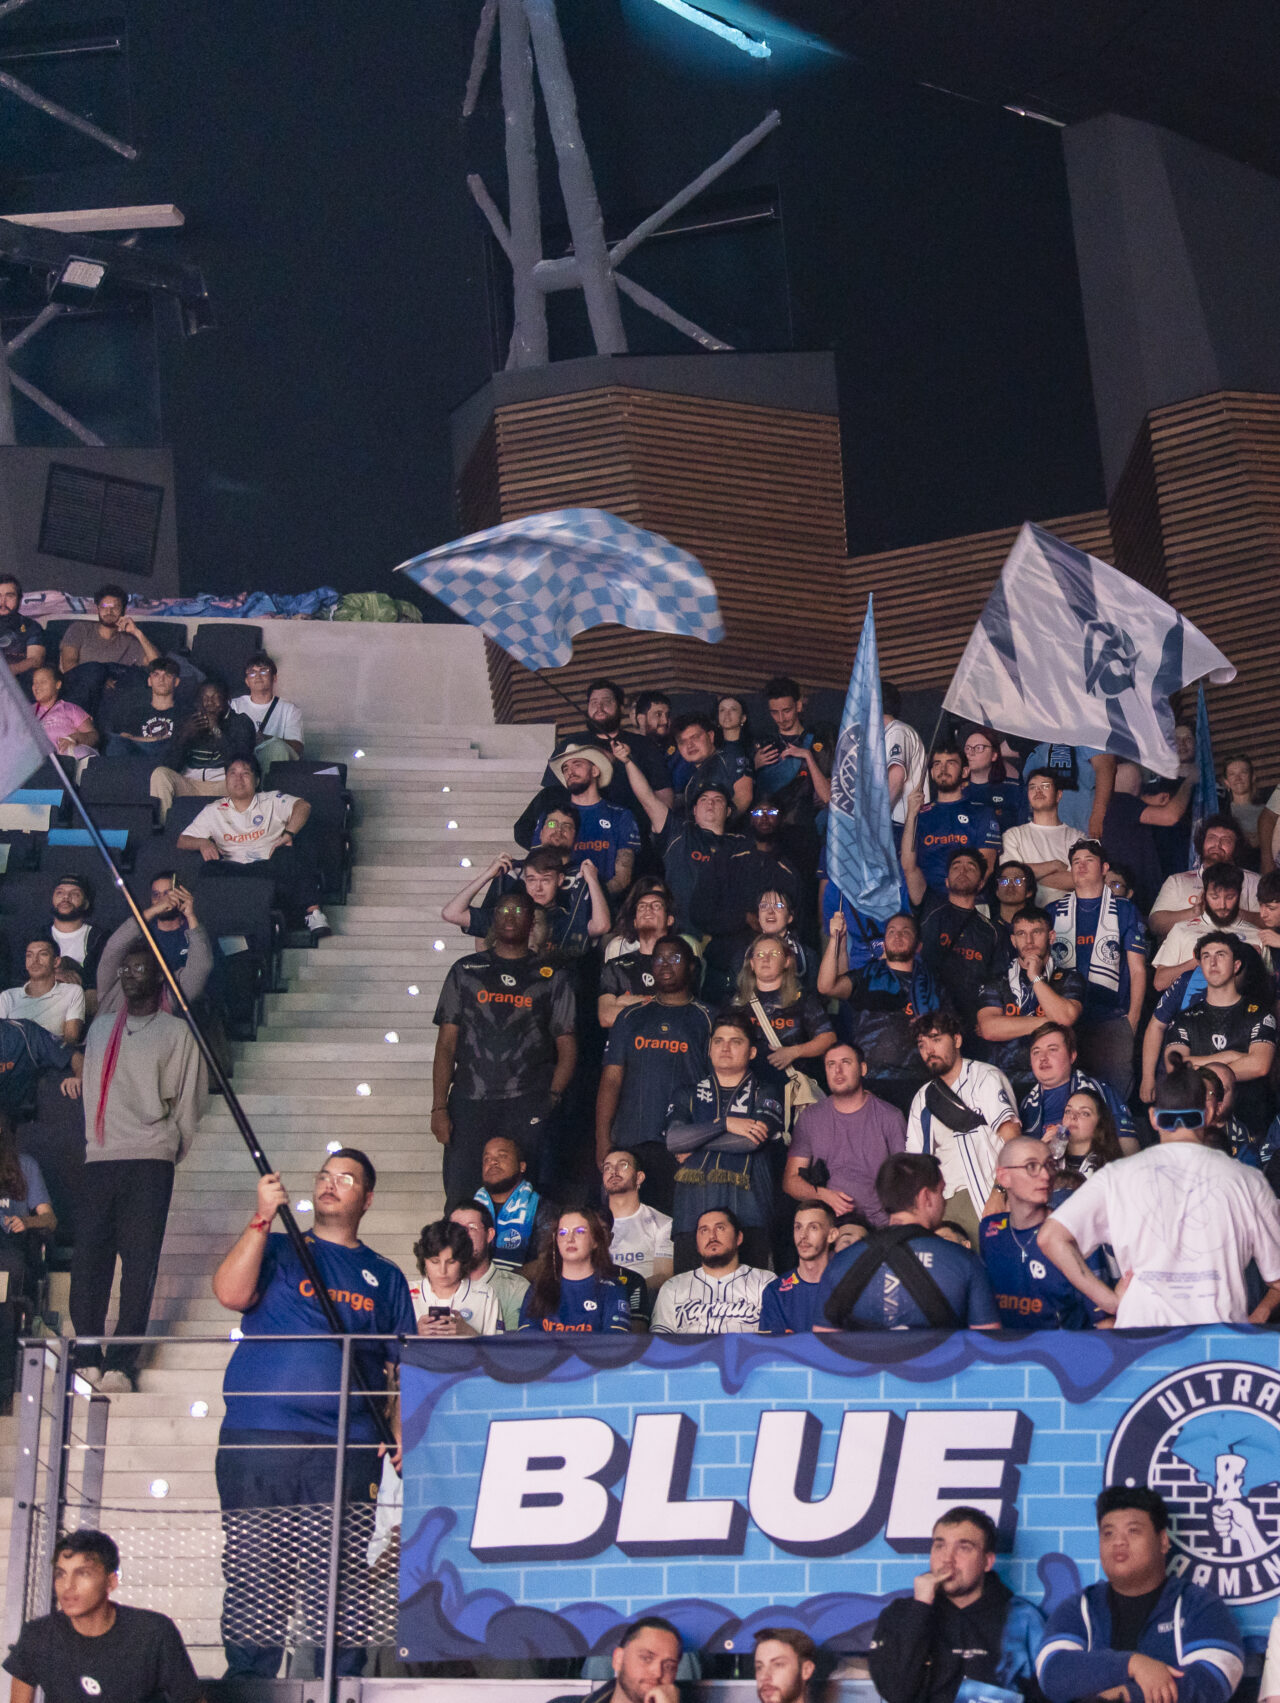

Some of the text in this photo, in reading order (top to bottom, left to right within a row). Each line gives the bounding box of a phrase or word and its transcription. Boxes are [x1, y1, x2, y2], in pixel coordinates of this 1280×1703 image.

[830, 775, 854, 812] WAL
[224, 830, 266, 844] Orange
[574, 838, 610, 851] range
[924, 834, 968, 847] Orange
[477, 990, 533, 1008] Orange
[634, 1035, 689, 1053] Orange
[299, 1279, 375, 1312] Oange
[469, 1409, 1034, 1563] BLUE
